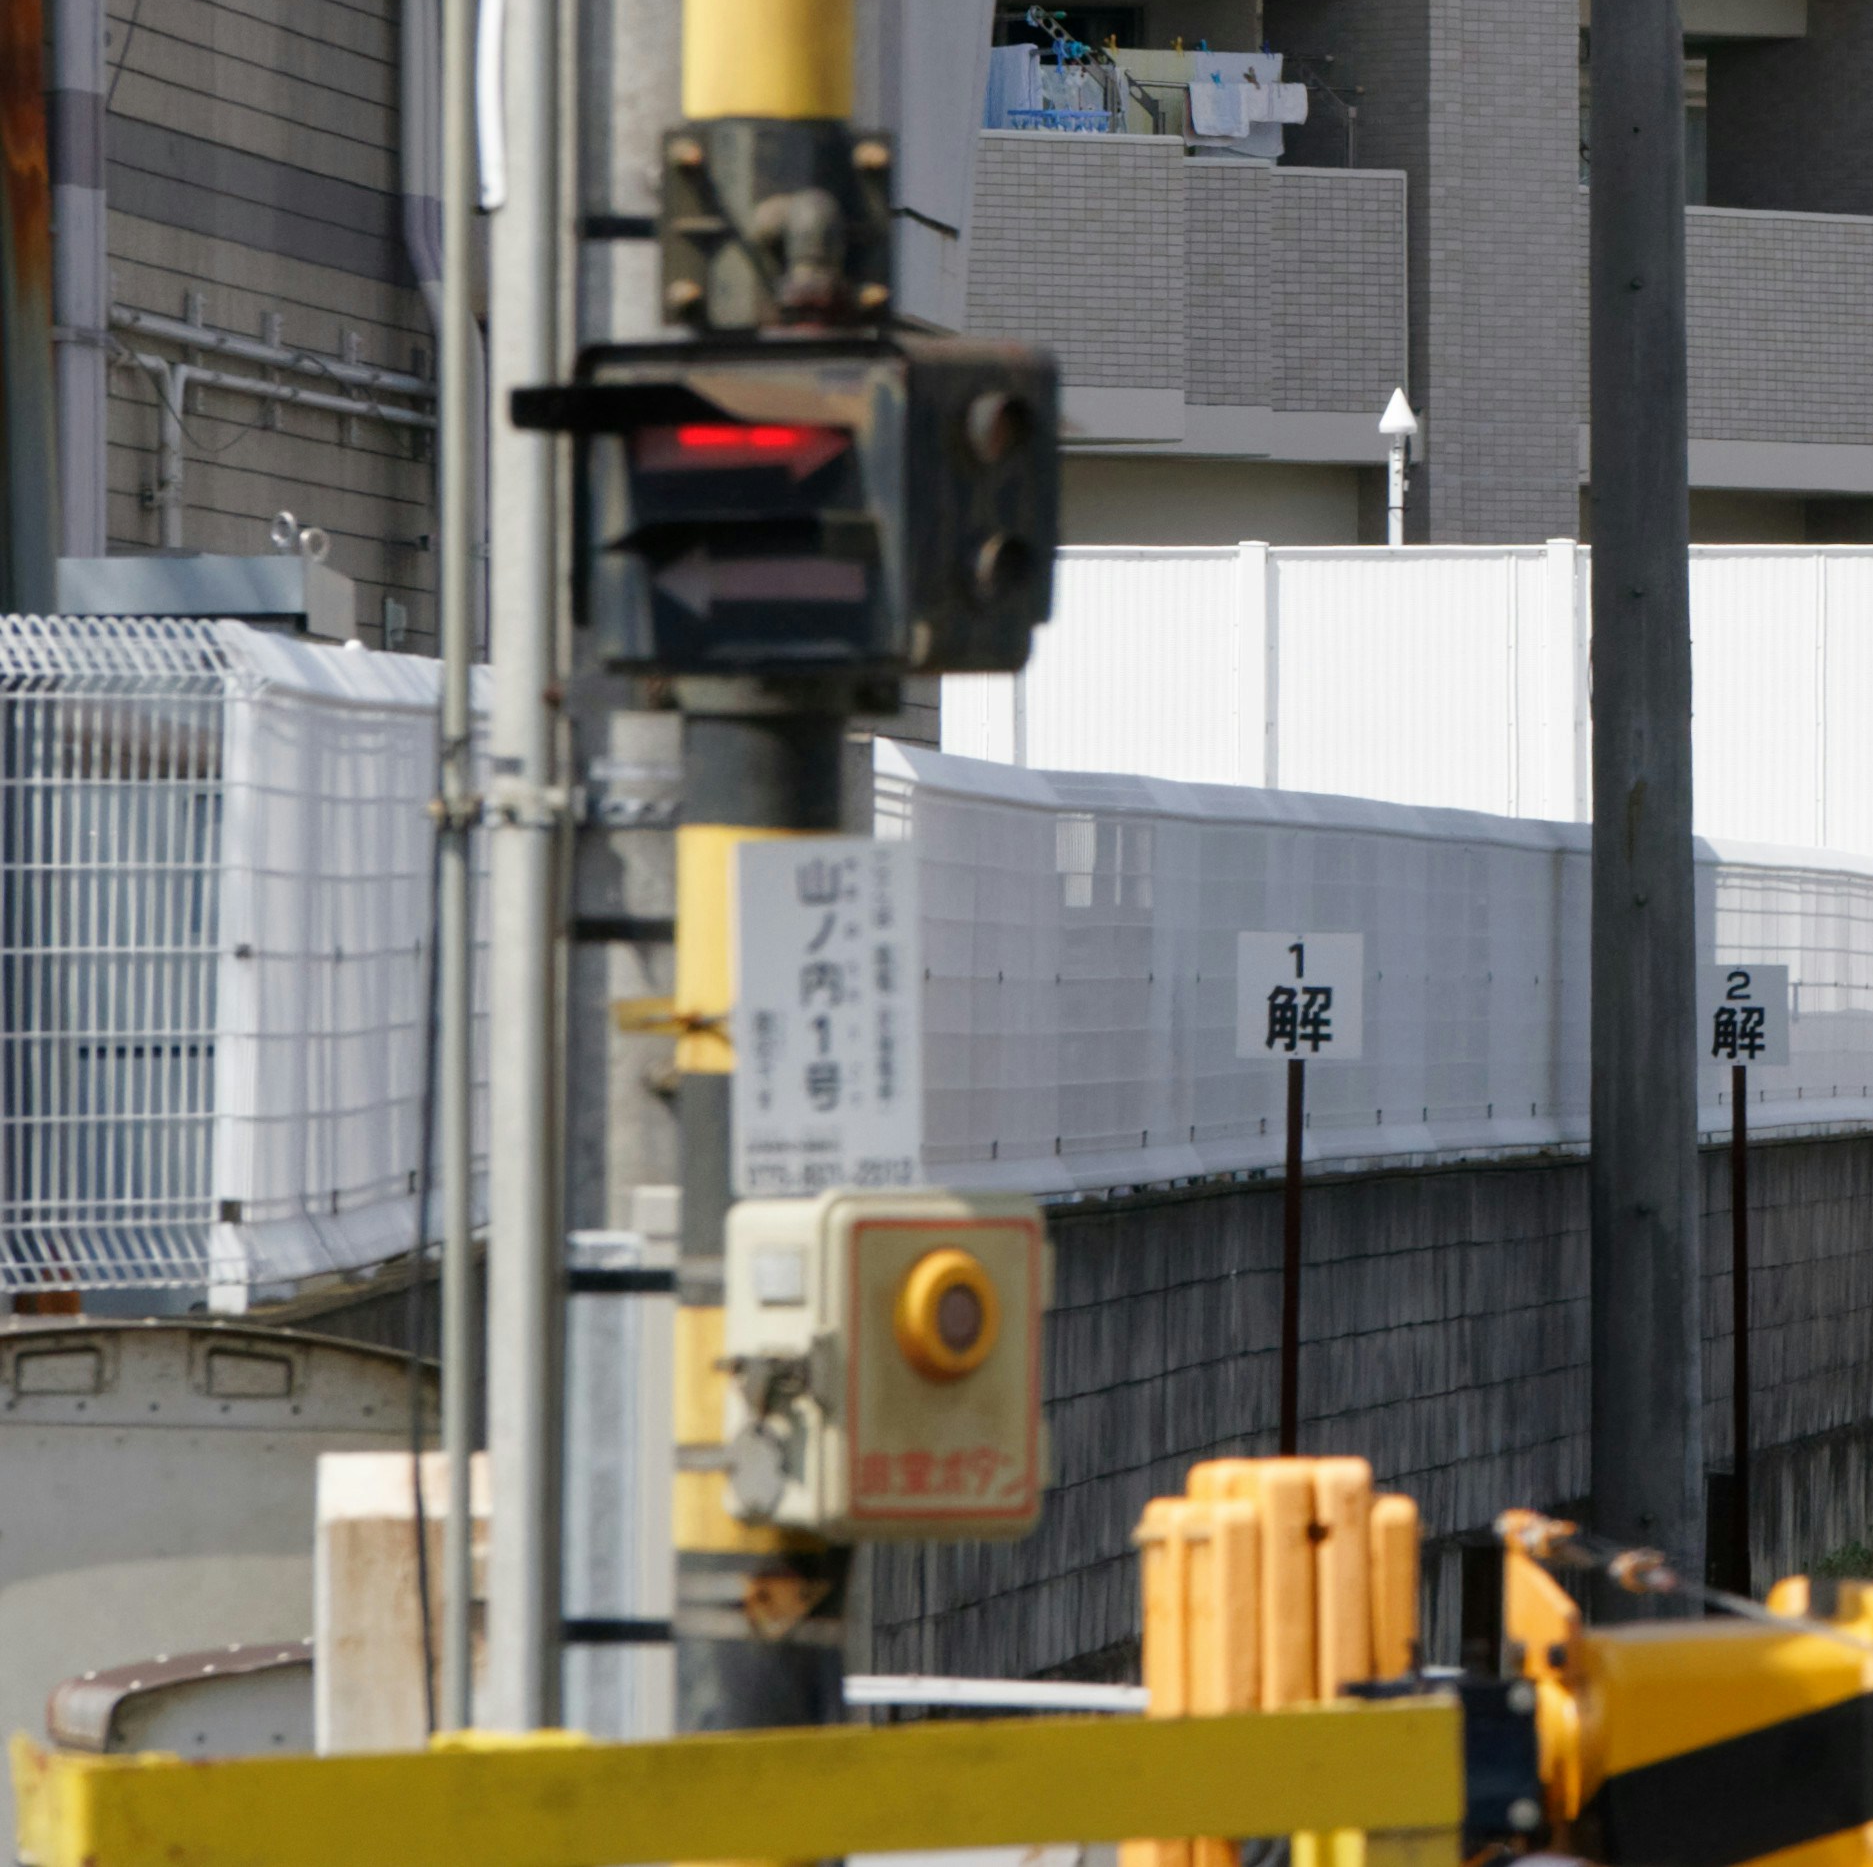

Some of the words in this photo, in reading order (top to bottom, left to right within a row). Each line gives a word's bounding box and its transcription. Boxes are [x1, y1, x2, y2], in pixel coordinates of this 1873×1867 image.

[1288, 942, 1304, 979] 1
[1726, 971, 1751, 1001] 2
[1265, 985, 1334, 1053] 解
[1711, 1006, 1766, 1060] 解
